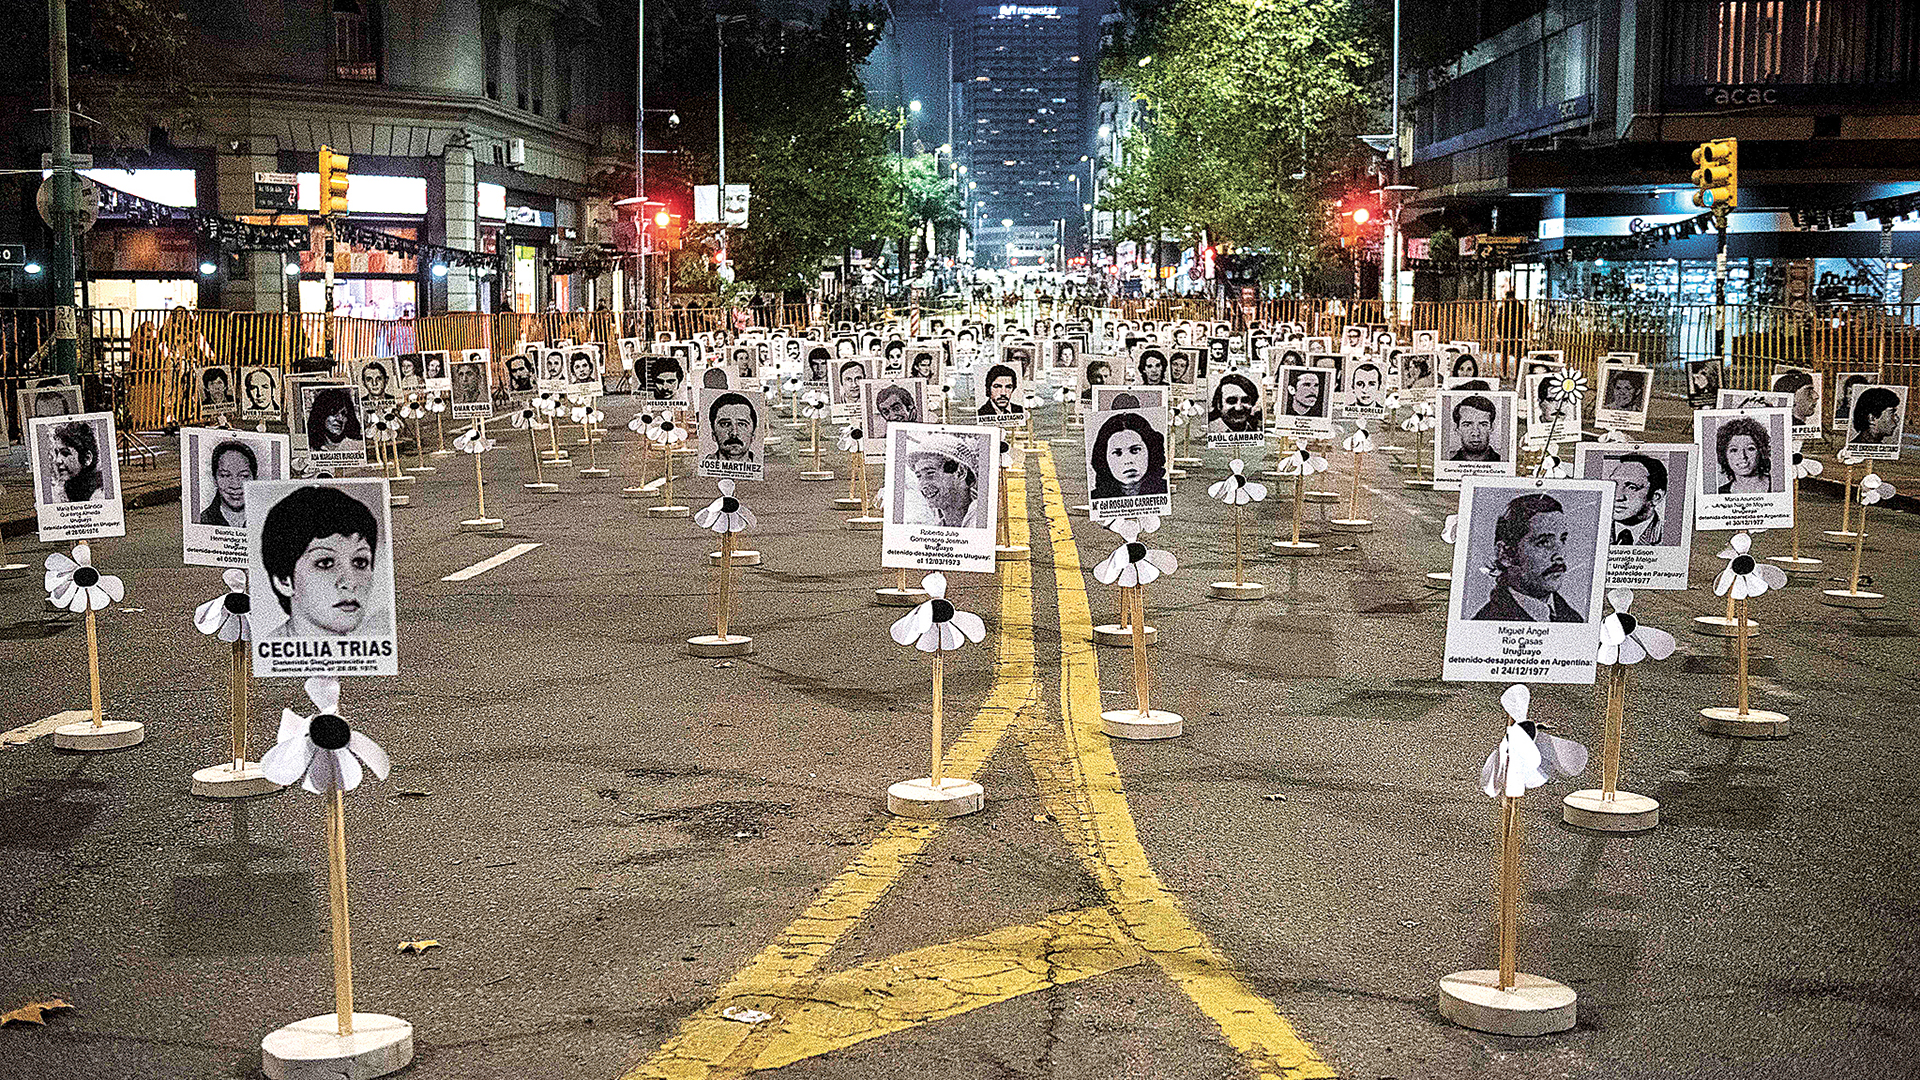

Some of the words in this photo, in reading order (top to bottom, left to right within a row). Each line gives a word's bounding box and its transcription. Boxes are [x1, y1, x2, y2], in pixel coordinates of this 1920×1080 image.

[1017, 5, 1058, 15] movistar
[1715, 88, 1776, 104] acac
[997, 414, 1024, 422] CASTAGNO
[1208, 433, 1227, 442] RAÚL
[1228, 432, 1264, 442] GÁMBARO
[1099, 500, 1109, 510] del
[1109, 498, 1134, 509] ROSARIO
[1134, 496, 1168, 507] CARRETERO
[924, 544, 954, 552] Uruguayo
[1632, 548, 1654, 556] Edison
[925, 557, 961, 567] 12/03/1973
[1612, 562, 1644, 570] Uruguayo
[1498, 626, 1526, 636] Miguel
[1526, 626, 1549, 637] Ángel
[1518, 637, 1543, 646] Casas
[258, 640, 333, 658] CECILIA
[337, 640, 392, 657] TRIAS
[1502, 648, 1542, 657] Uruguayo
[1448, 656, 1539, 666] detenido-desaparecido
[1551, 657, 1593, 667] Argentina:
[1500, 667, 1549, 676] 24/12/1977
